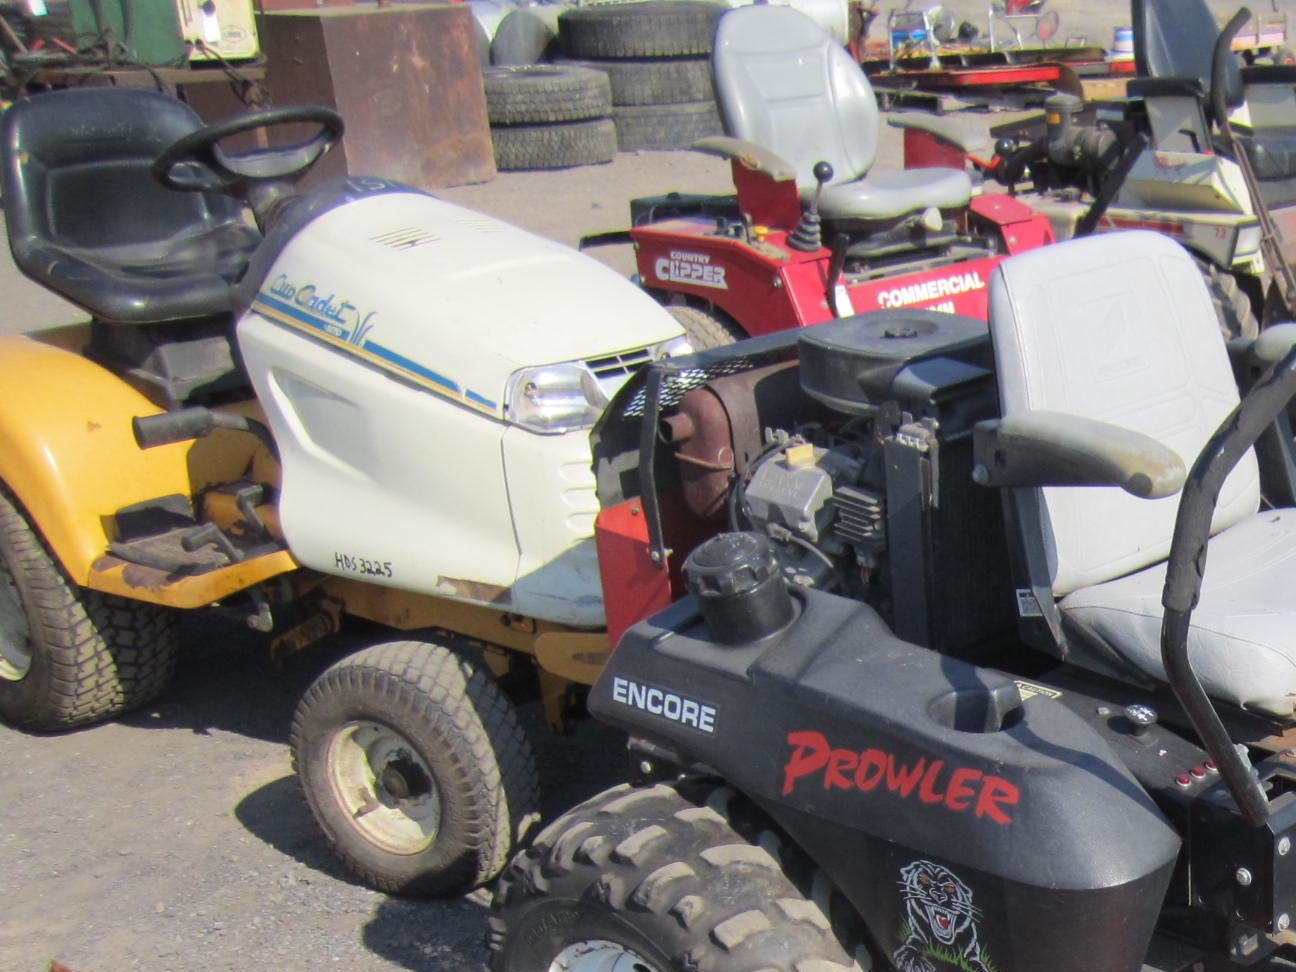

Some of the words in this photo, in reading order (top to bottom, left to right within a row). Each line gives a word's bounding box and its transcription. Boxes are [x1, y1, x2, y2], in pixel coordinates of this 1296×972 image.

[655, 257, 729, 290] CLIPPER
[670, 250, 711, 264] COUNTRY
[294, 284, 357, 325] Cadet
[877, 271, 985, 308] COMMERCIAL
[613, 677, 716, 733] ENCORE
[783, 731, 1019, 824] PROWLER
